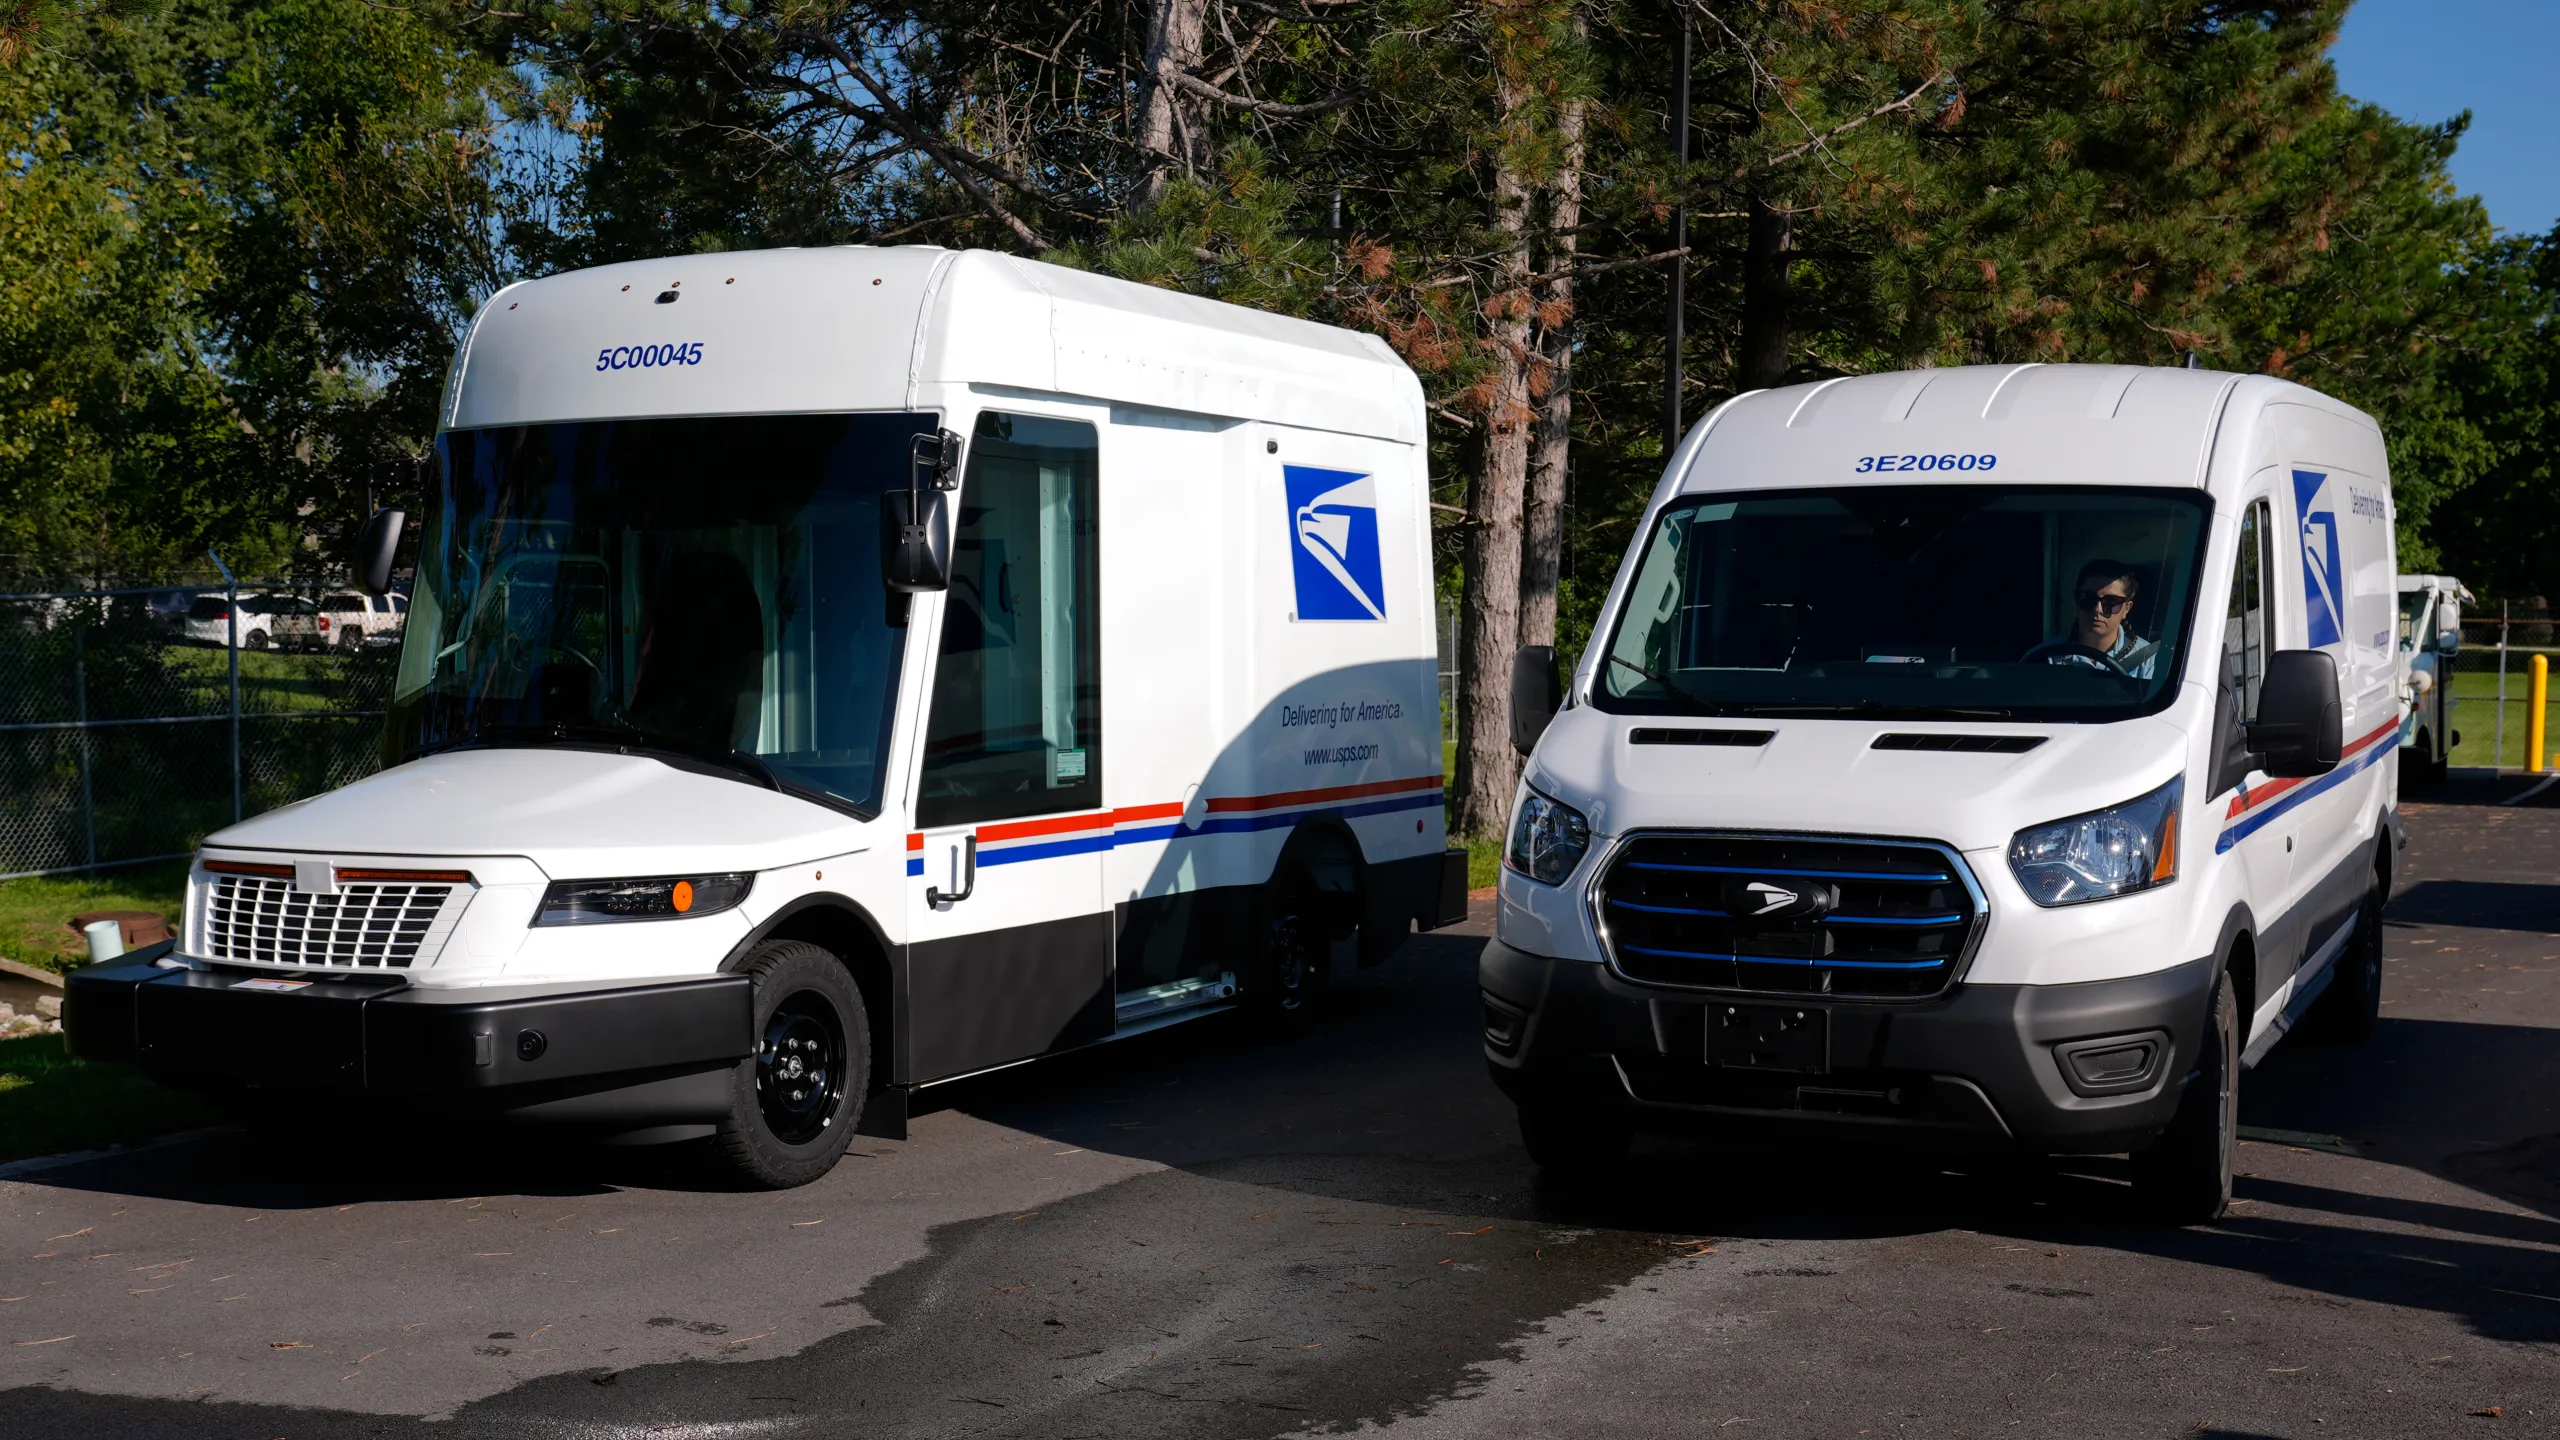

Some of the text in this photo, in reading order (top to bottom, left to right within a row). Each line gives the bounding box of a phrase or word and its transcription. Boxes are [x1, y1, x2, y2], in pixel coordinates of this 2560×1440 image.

[596, 342, 704, 372] 5C00045
[1855, 454, 1997, 473] 3E20609
[1282, 703, 1338, 729] Delivering
[1340, 701, 1356, 722] for
[1304, 744, 1379, 767] www.usps.com
